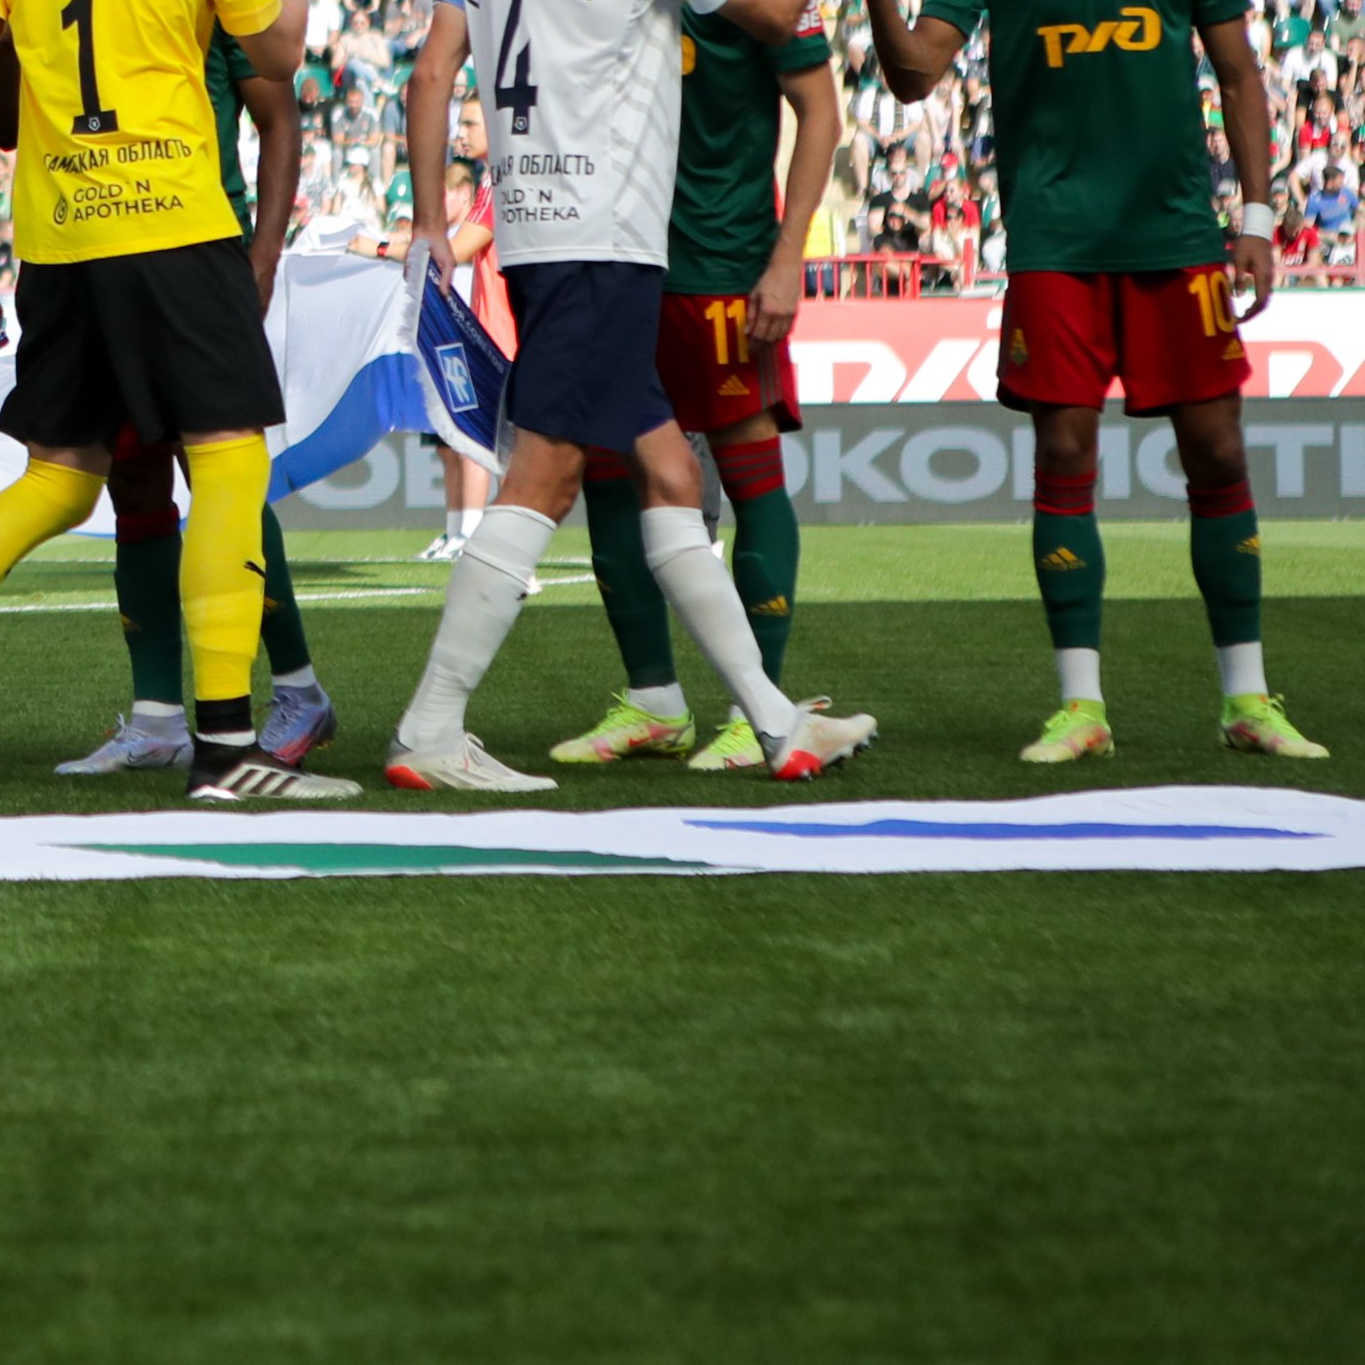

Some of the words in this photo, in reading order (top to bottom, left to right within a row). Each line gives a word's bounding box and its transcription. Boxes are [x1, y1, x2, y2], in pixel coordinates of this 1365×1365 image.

[117, 138, 192, 163] ОБЛАСТЬ
[73, 195, 184, 223] APOTHEKA
[1188, 270, 1236, 337] 10
[704, 298, 749, 365] 11
